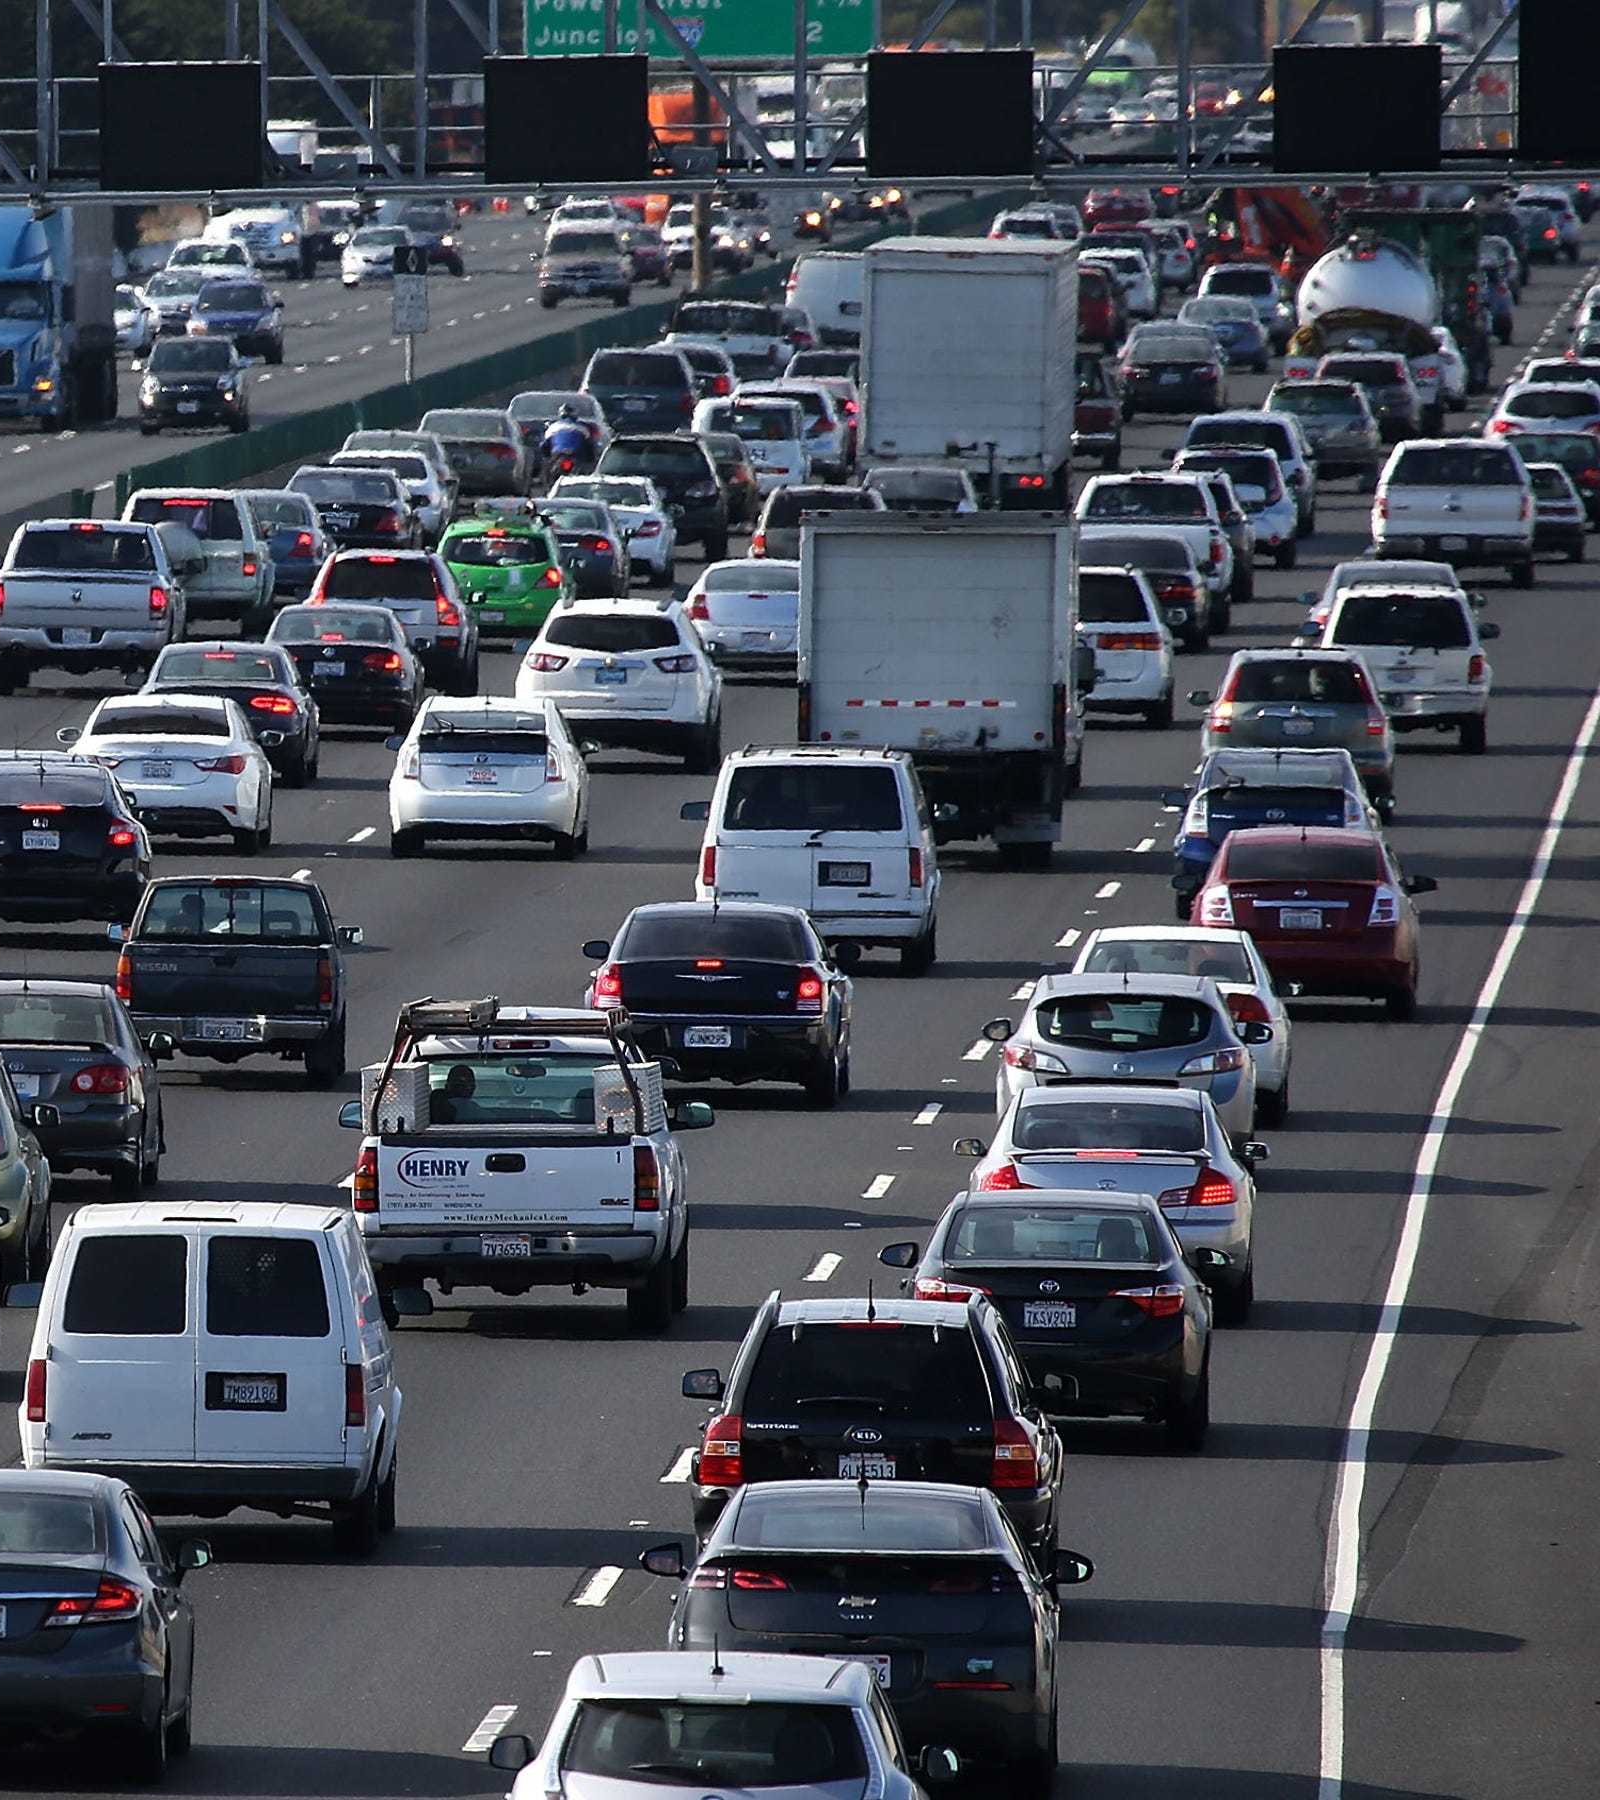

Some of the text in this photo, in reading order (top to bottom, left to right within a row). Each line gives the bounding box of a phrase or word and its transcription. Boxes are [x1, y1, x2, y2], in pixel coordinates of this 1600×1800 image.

[534, 25, 656, 47] Juncion
[806, 21, 823, 42] 2
[136, 963, 178, 971] NISSAN
[616, 1151, 621, 1163] 1
[404, 1160, 470, 1177] HENRY
[444, 1213, 568, 1223] www.HenryMechanical.com
[483, 1243, 529, 1256] 7V36553
[1026, 1311, 1073, 1324] 7KSV901
[226, 1385, 275, 1400] 7M89186
[71, 1432, 112, 1440] ASTRO
